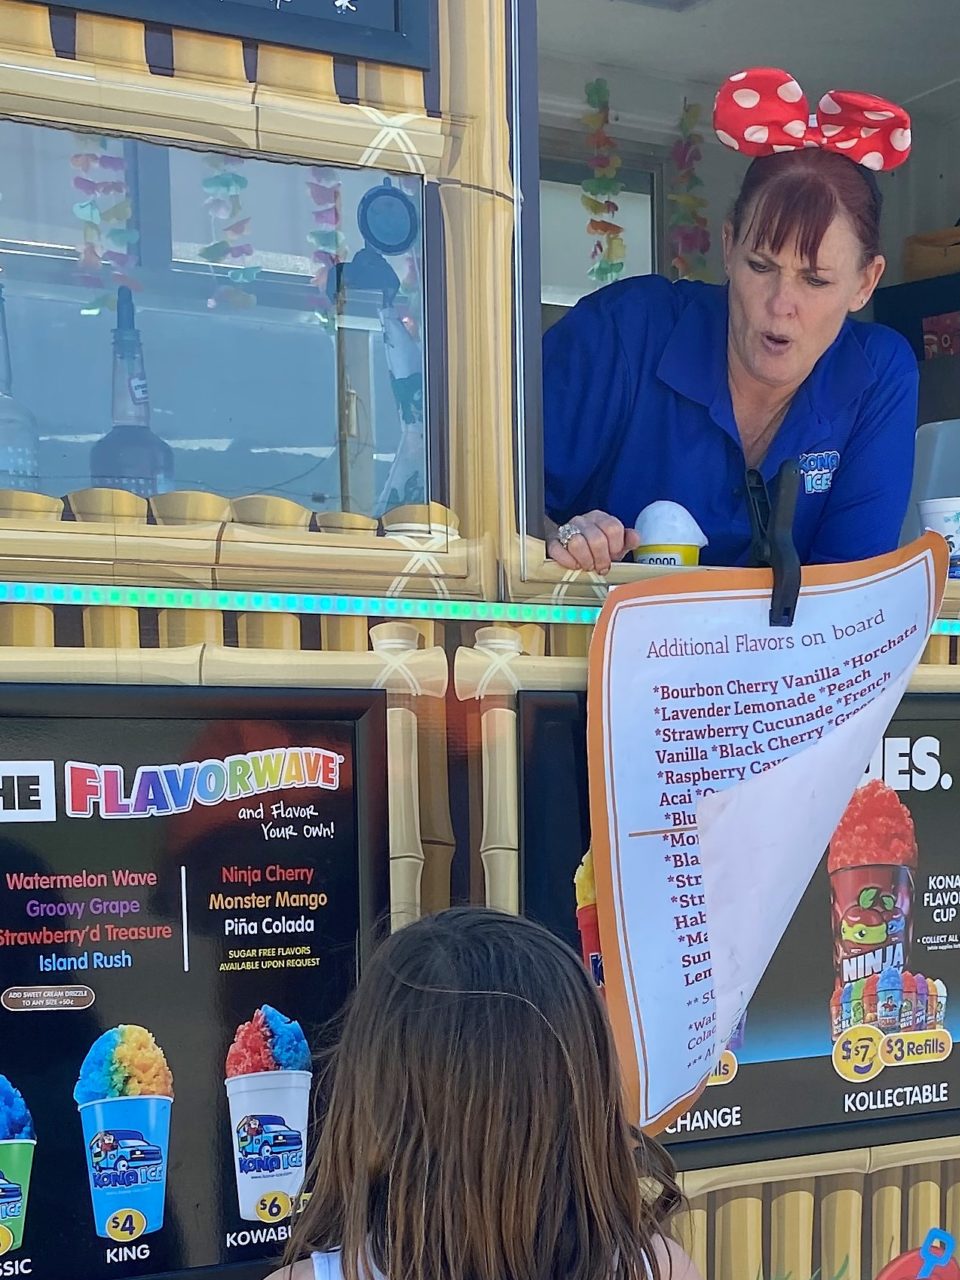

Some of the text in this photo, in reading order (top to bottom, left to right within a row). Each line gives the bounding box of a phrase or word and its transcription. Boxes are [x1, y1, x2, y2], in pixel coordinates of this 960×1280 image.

[805, 473, 832, 494] ICE
[646, 608, 885, 659] Additional Flavors on board
[726, 679, 779, 695] Cherry
[782, 666, 841, 689] Vanilla
[734, 692, 816, 715] Lemonade
[752, 705, 833, 734] Cucunade
[655, 747, 708, 764] Vanilla
[767, 725, 824, 751] Cherry
[65, 747, 341, 819] FLAVORWAVE
[659, 789, 693, 806] Acai
[238, 803, 264, 819] and
[6, 869, 158, 890] Watermelon Wave
[222, 864, 314, 886] Ninja Cherry
[26, 897, 140, 919] Groovy Grape
[209, 891, 328, 911] Monster Mango
[933, 907, 957, 923] CUP
[105, 924, 173, 942] Treasure
[224, 916, 315, 936] Piña Colada
[921, 935, 947, 944] COLLECT
[948, 934, 959, 942] ALL
[39, 950, 132, 972] Island Rush
[228, 946, 311, 959] SUGAR FREE FLAVORS
[842, 943, 905, 983] NINJA
[219, 958, 320, 972] AVAILABLE UPON REQUEST
[886, 1037, 945, 1061] $3 Refills
[844, 1082, 949, 1113] KOLLECTABLE
[238, 1150, 304, 1174] KONA ICE
[92, 1164, 163, 1188] KONA ICE
[1, 1202, 22, 1219] ICE
[260, 1197, 282, 1217] $6
[111, 1214, 136, 1235] $4
[106, 1244, 150, 1264] KING
